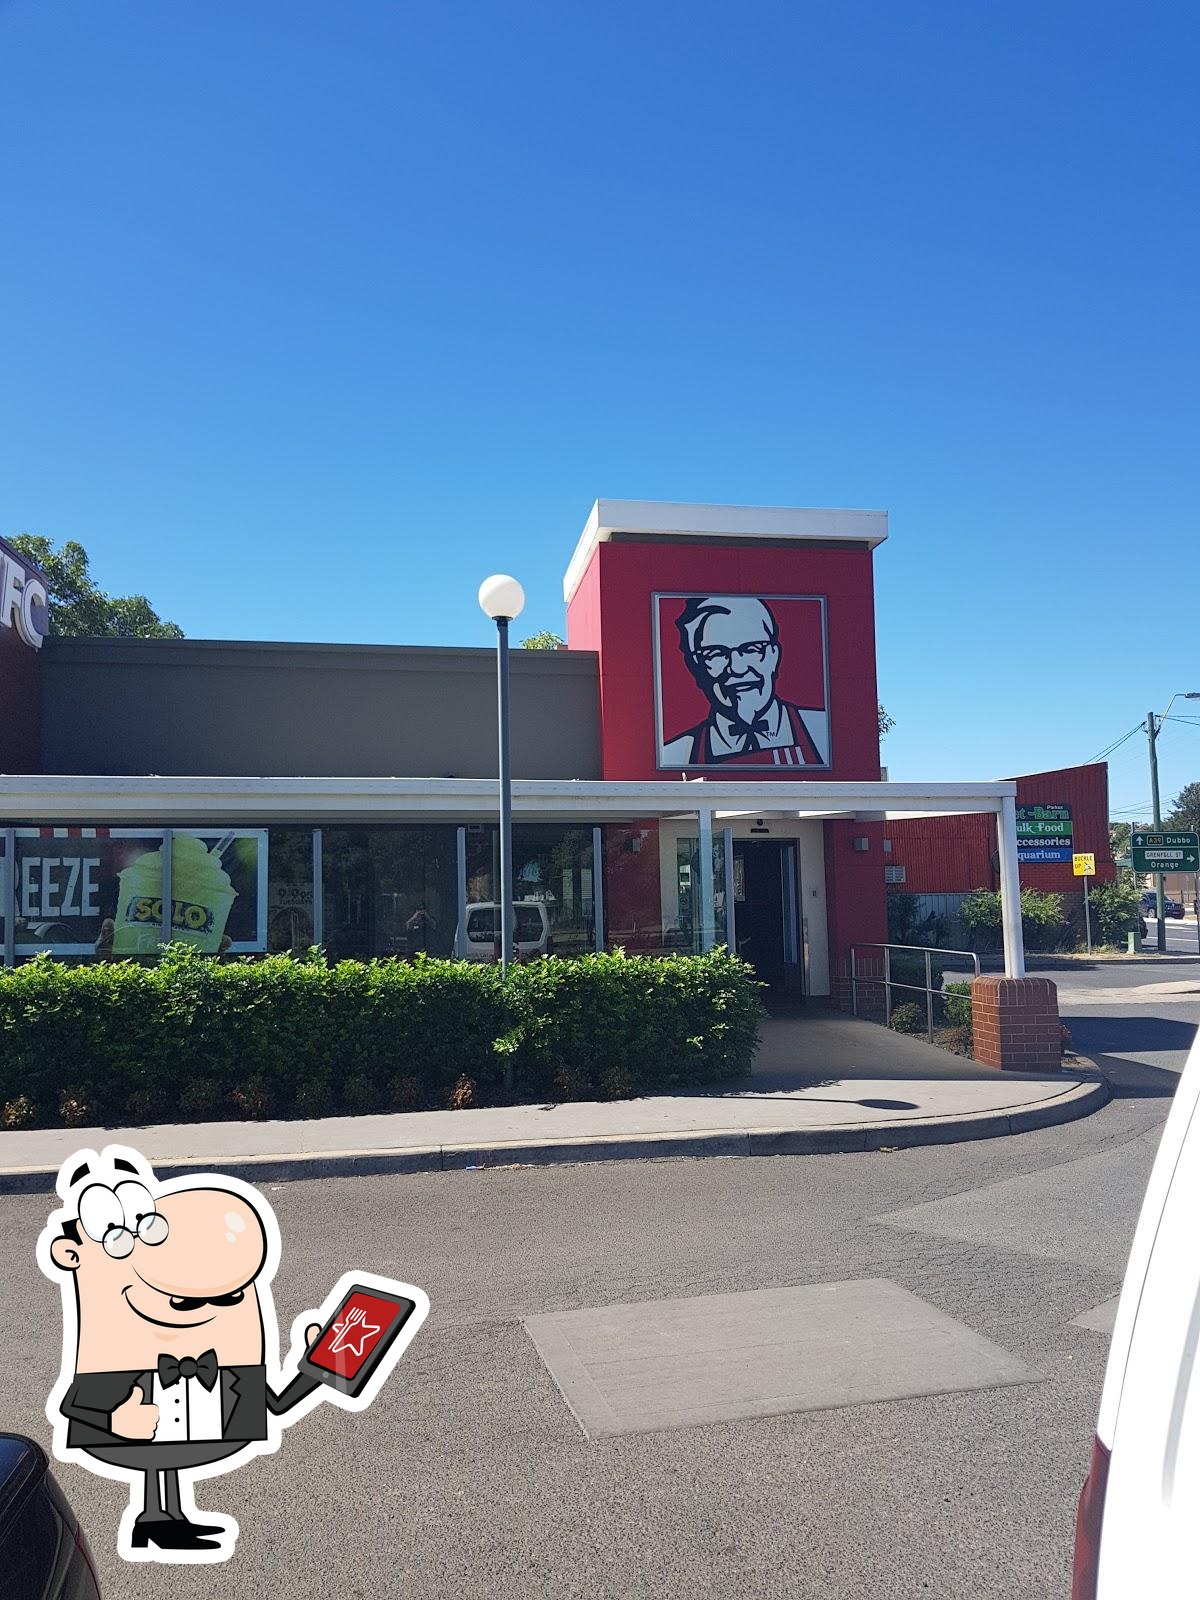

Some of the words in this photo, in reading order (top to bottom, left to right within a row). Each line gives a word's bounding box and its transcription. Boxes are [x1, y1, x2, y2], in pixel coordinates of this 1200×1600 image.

[0, 552, 46, 649] FC
[1028, 807, 1069, 819] Barn
[1016, 822, 1036, 833] ulk
[1036, 822, 1064, 832] Food
[1016, 837, 1071, 846] ccessories
[1017, 850, 1061, 862] quarium
[1150, 861, 1179, 869] Orange
[135, 898, 207, 928] SOLO
